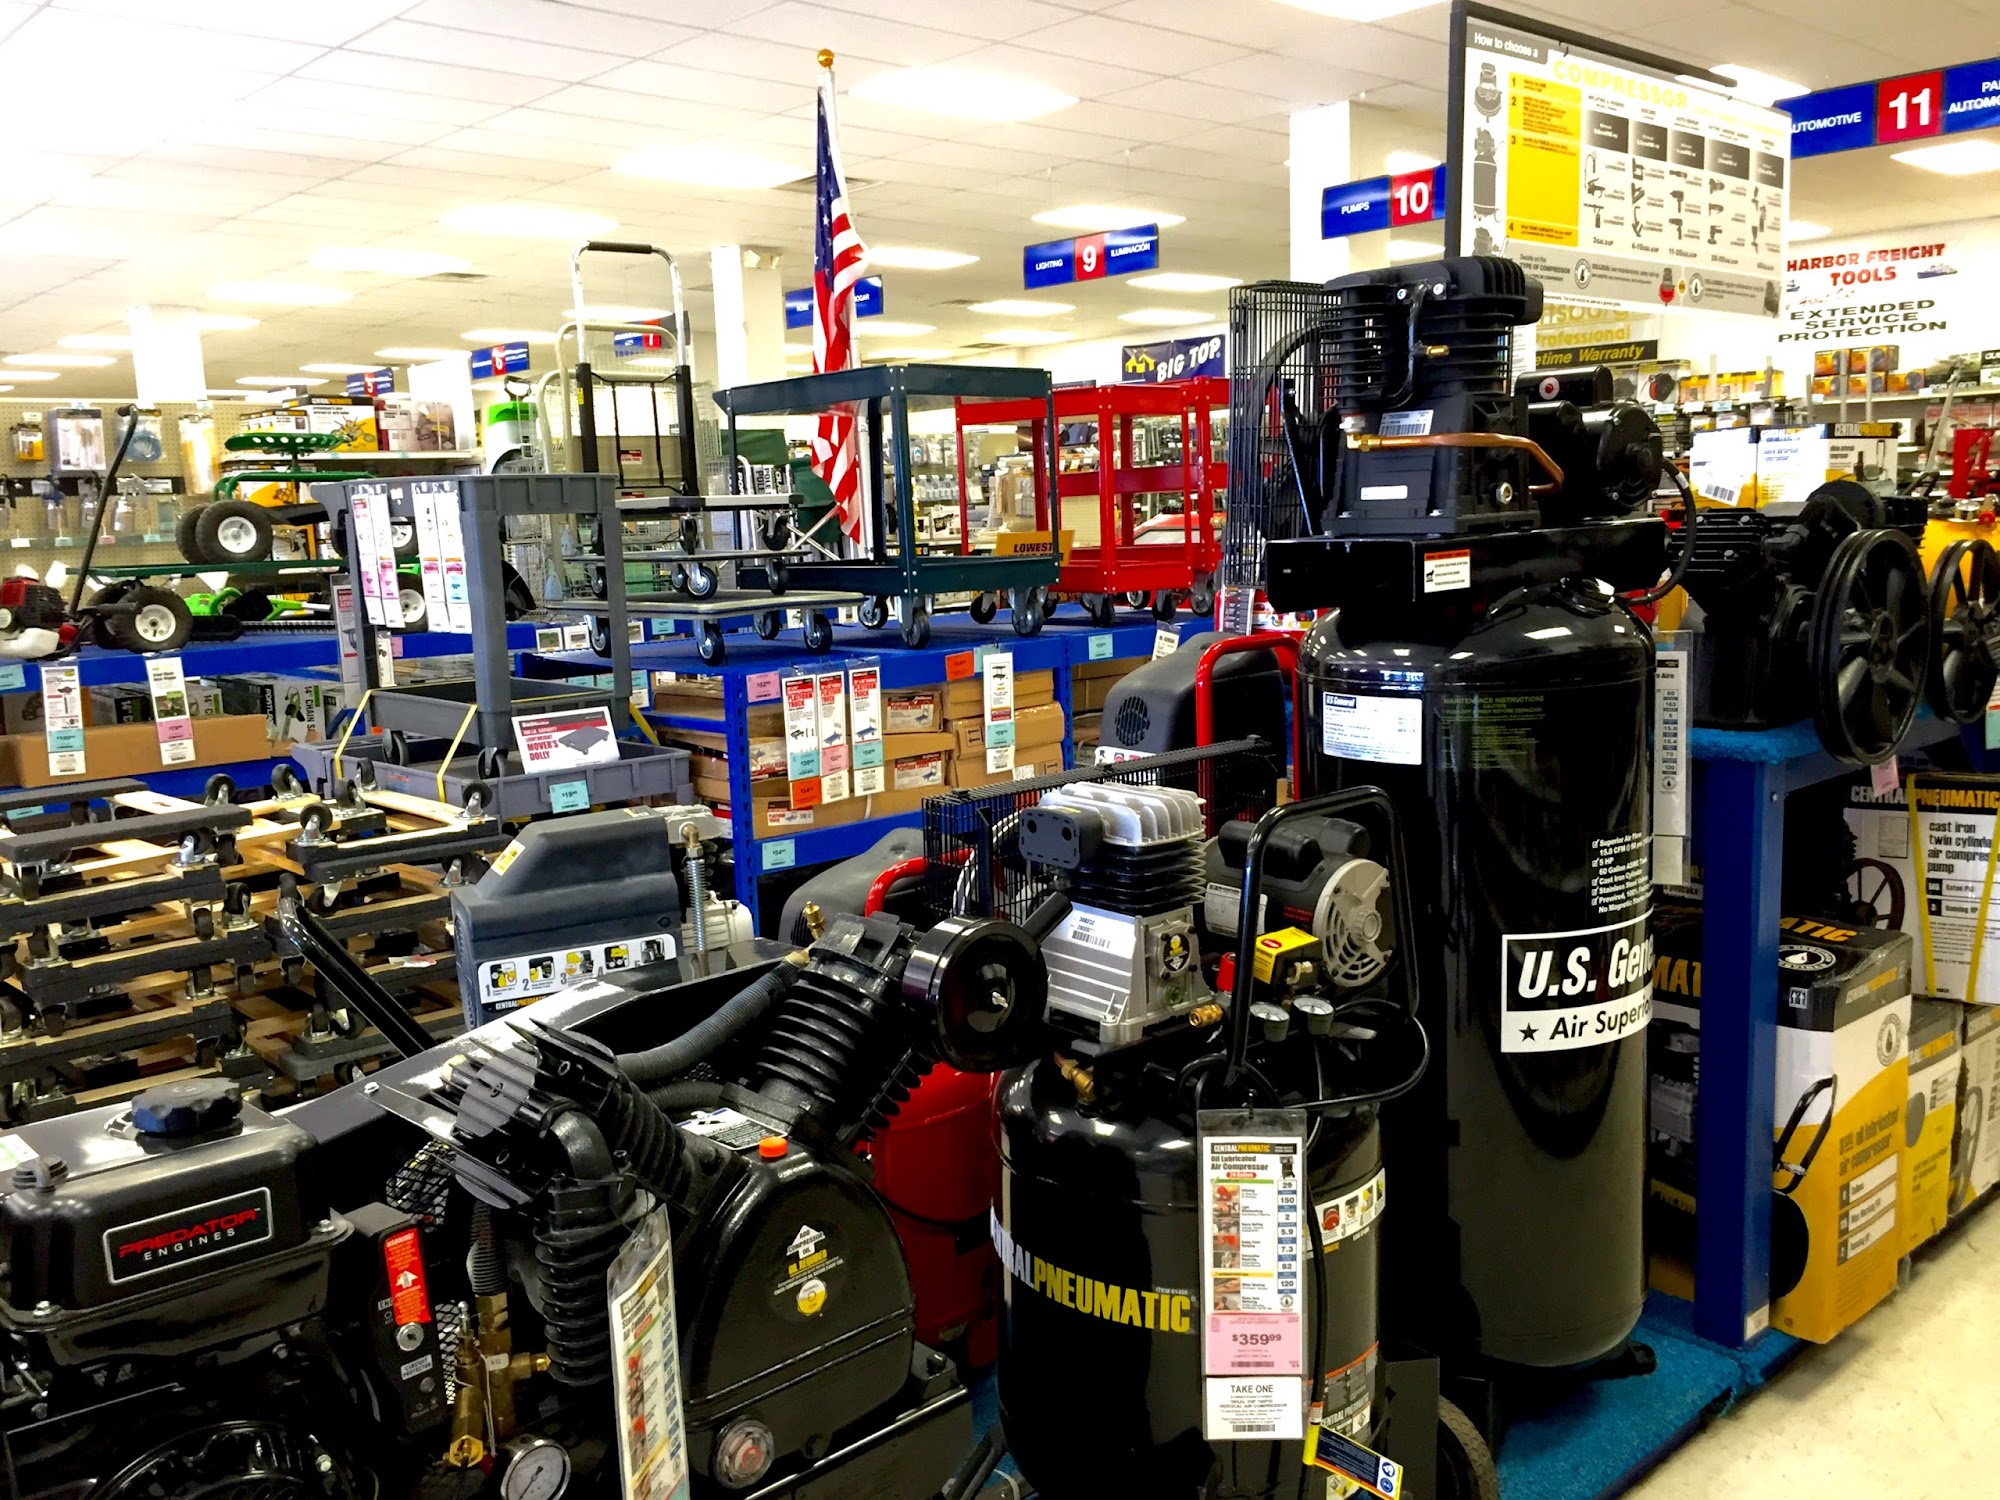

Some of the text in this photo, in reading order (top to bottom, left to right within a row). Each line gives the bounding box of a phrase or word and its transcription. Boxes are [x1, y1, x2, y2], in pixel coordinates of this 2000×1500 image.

[1474, 32, 1538, 58] How to choose a
[1511, 77, 1516, 88] 1
[1553, 59, 1688, 110] COMPRESSOR
[1511, 96, 1517, 106] 2
[1888, 87, 1931, 130] 11
[1511, 135, 1516, 145] 3
[1341, 181, 1429, 217] PUMPS 10
[1509, 222, 1514, 232] 4
[1035, 258, 1063, 271] LIGHTING
[1082, 245, 1097, 272] 9
[1786, 252, 1860, 272] HARBOR
[1866, 243, 1946, 264] FREIGHT
[1830, 266, 1897, 286] TOOLS
[1790, 299, 1936, 321] EXTENDED
[1804, 311, 1919, 330] SERVICE
[1777, 320, 1947, 343] PROTECTION
[1156, 336, 1221, 383] BIG TOP
[1579, 344, 1646, 362] Warranty
[1013, 542, 1053, 553] LOWEST
[1494, 695, 1544, 704] INSTRUCTIONS
[527, 740, 559, 752] MOVER'S
[529, 750, 550, 761] DOLLY
[1850, 786, 1908, 805] CENTRA
[1929, 821, 1976, 834] cast iron
[1599, 836, 1624, 847] Superior
[1624, 834, 1632, 842] Air
[1929, 834, 1992, 850] twin cylinde
[1928, 848, 1943, 859] air
[1604, 857, 1614, 865] HP
[1608, 865, 1626, 874] Gallon
[1927, 862, 1954, 875] pump
[1599, 876, 1614, 885] Cast
[1614, 874, 1626, 882] Iron
[1599, 884, 1626, 895] Stainless
[1599, 906, 1608, 914] No
[560, 972, 567, 985] 3
[1518, 946, 1598, 999] U.S.
[485, 984, 491, 997] 1
[522, 978, 530, 992] 2
[1549, 998, 1588, 1040] Air
[1222, 1163, 1269, 1171] Compressor
[1282, 1181, 1293, 1189] 29
[1285, 1213, 1290, 1221] 2
[118, 1208, 257, 1259] PREDATOR
[800, 1229, 810, 1239] ADD
[144, 1227, 236, 1261] ENGINES
[788, 1231, 824, 1253] COMPRESSOR
[802, 1246, 811, 1255] OIL
[403, 1362, 432, 1378] PROTECTOR
[404, 1356, 429, 1371] CIRCUIT
[1231, 1384, 1274, 1393] TAKE ONE
